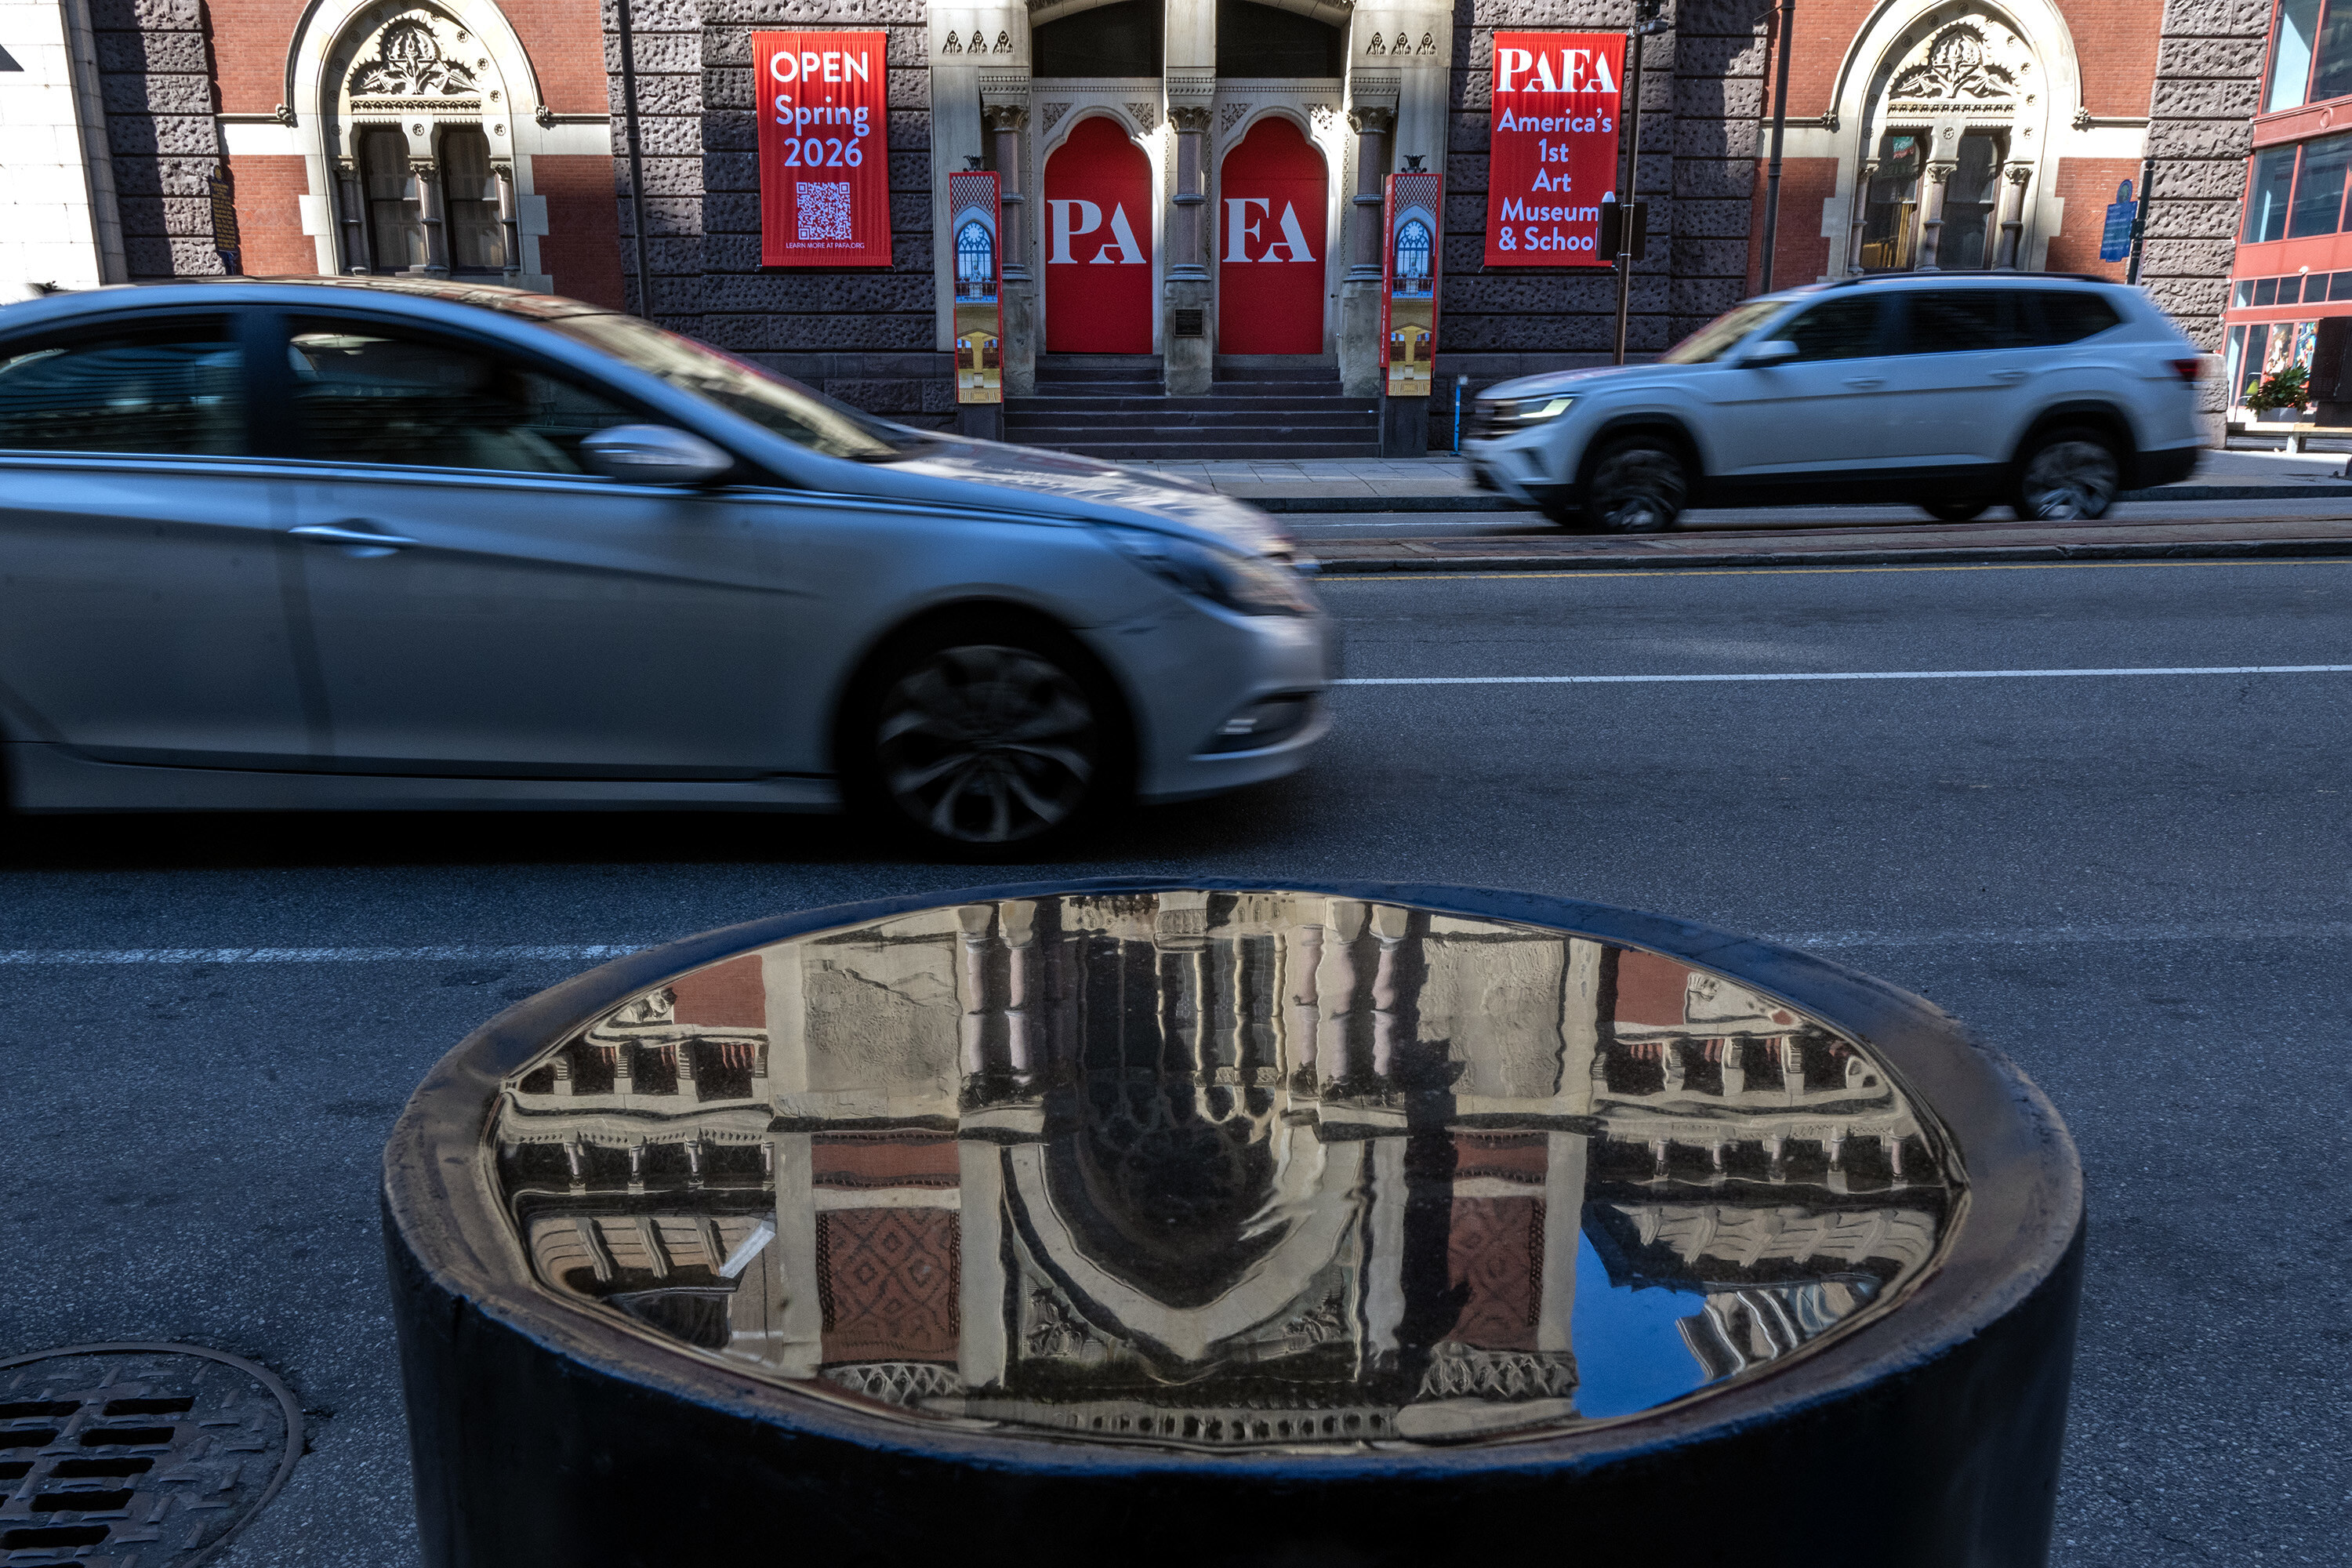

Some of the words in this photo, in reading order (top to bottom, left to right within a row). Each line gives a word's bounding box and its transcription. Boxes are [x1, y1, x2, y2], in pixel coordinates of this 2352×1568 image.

[770, 51, 869, 83] OPEN
[1496, 48, 1619, 93] PAFA
[775, 94, 870, 137] Spring
[1497, 107, 1613, 133] America's
[784, 137, 863, 167] 2026
[1538, 138, 1570, 163] 1st
[1531, 167, 1572, 193] Art
[1500, 197, 1599, 222] Museum
[1047, 199, 1147, 264] PA
[1221, 198, 1317, 263] FA
[1498, 226, 1518, 251] &
